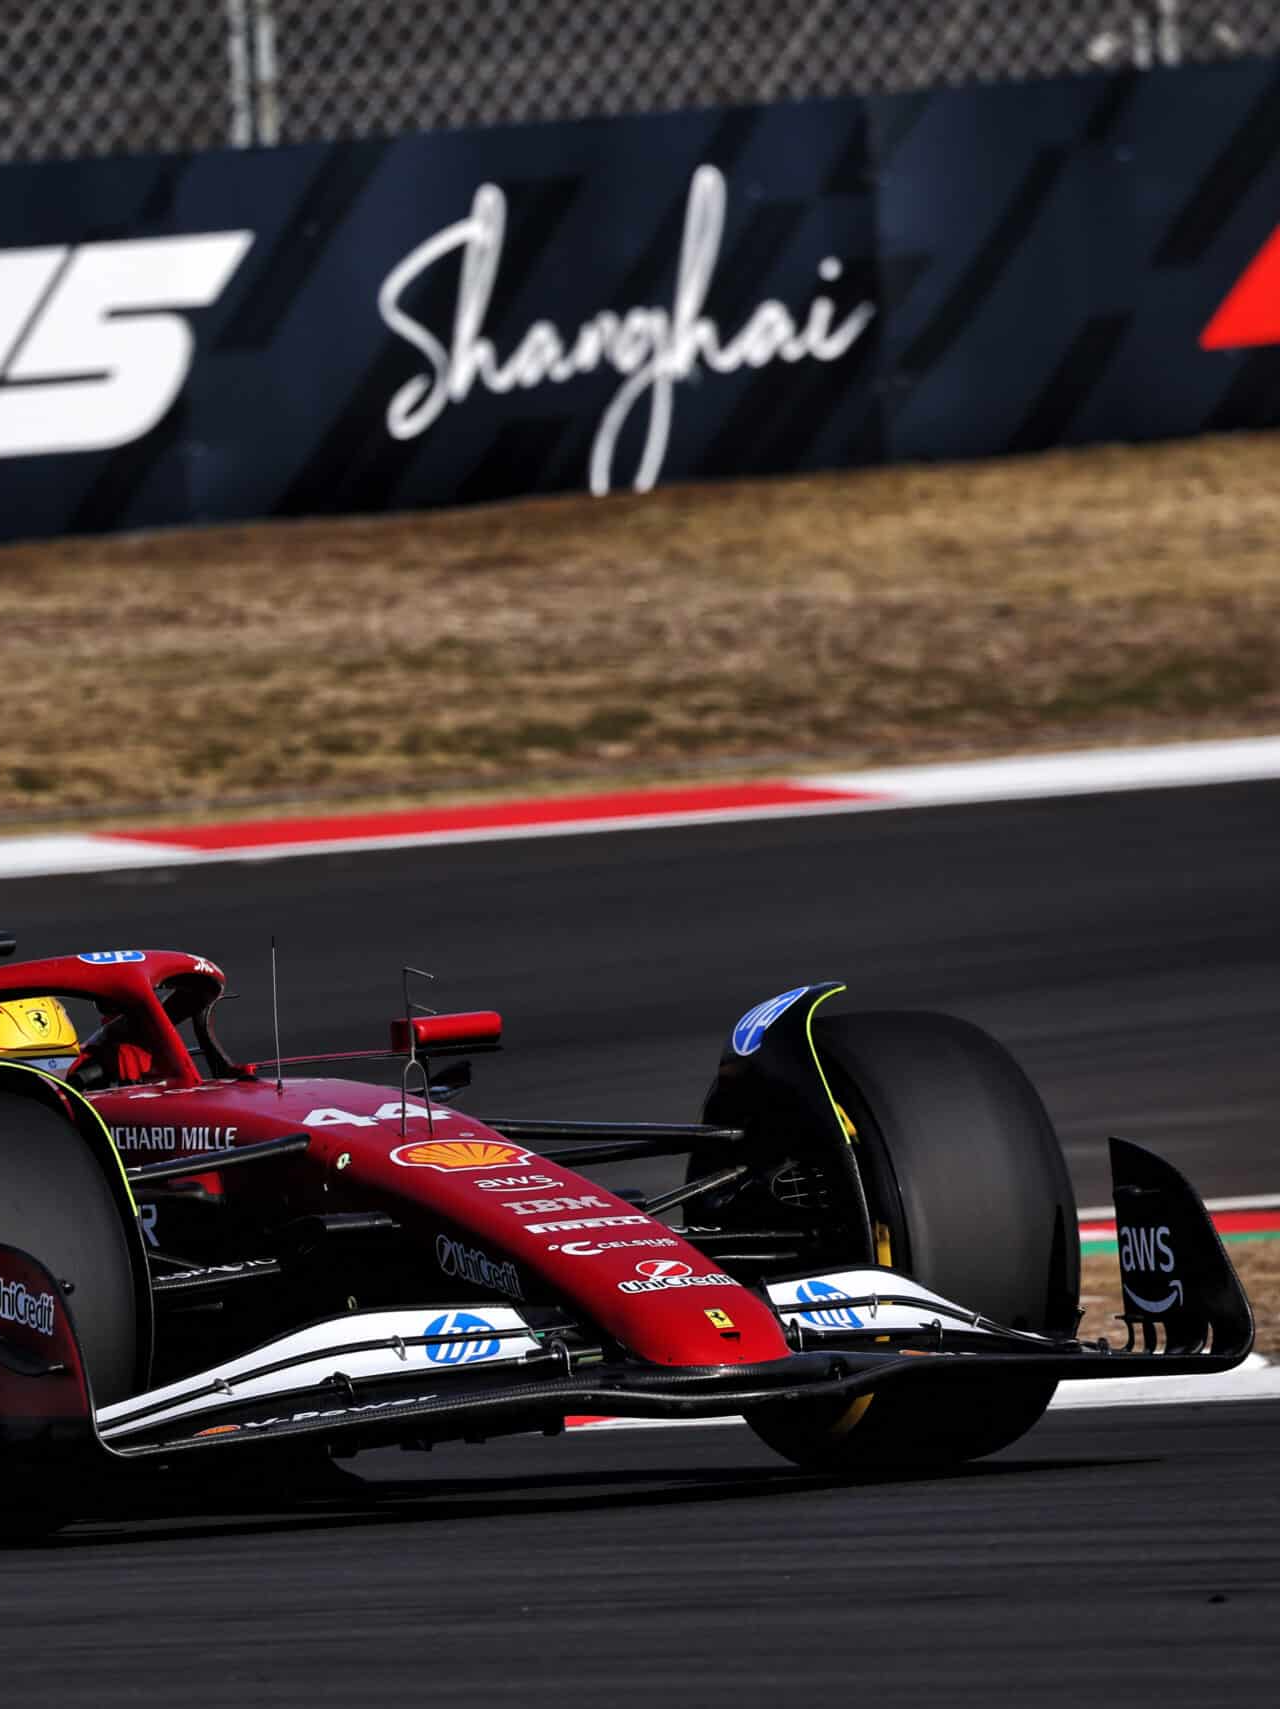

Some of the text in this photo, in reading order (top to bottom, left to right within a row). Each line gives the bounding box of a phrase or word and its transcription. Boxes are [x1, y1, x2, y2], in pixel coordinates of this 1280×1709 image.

[378, 164, 875, 497] Shanghai
[302, 1100, 452, 1128] 44
[111, 1127, 238, 1151] ICHARD MILLE
[473, 1174, 554, 1189] aws
[500, 1195, 613, 1215] IBM
[523, 1215, 652, 1234] PIRELLI
[1121, 1225, 1176, 1273] aws
[620, 1274, 741, 1293] UniCredit
[432, 1312, 493, 1363] hp
